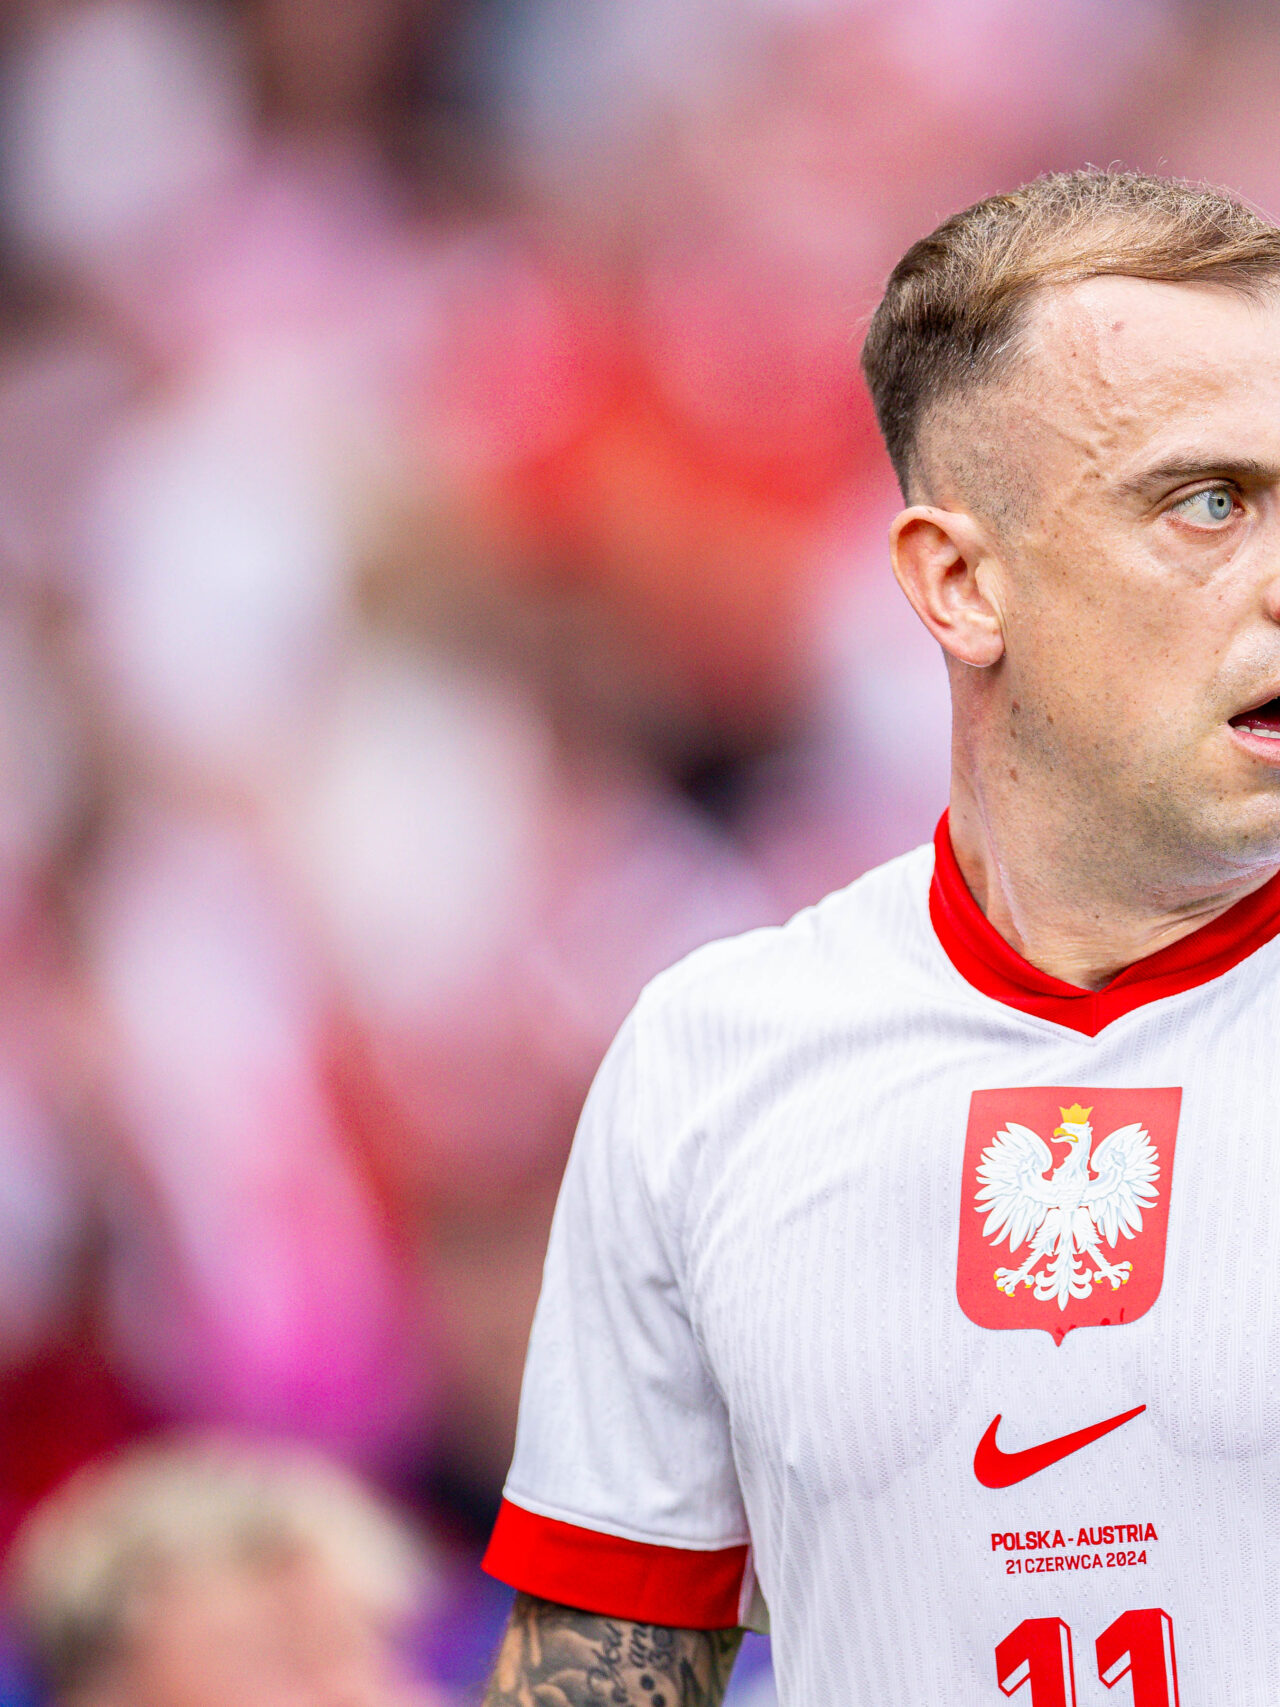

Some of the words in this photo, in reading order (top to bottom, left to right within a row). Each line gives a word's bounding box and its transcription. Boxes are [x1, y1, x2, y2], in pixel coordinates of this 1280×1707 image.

[990, 1530, 1066, 1551] POLSKA
[1076, 1522, 1159, 1546] AUSTRIA
[1005, 1559, 1022, 1574] 21
[1024, 1553, 1104, 1574] CZERWCA
[1105, 1550, 1148, 1568] 2024
[994, 1608, 1180, 1707] 11
